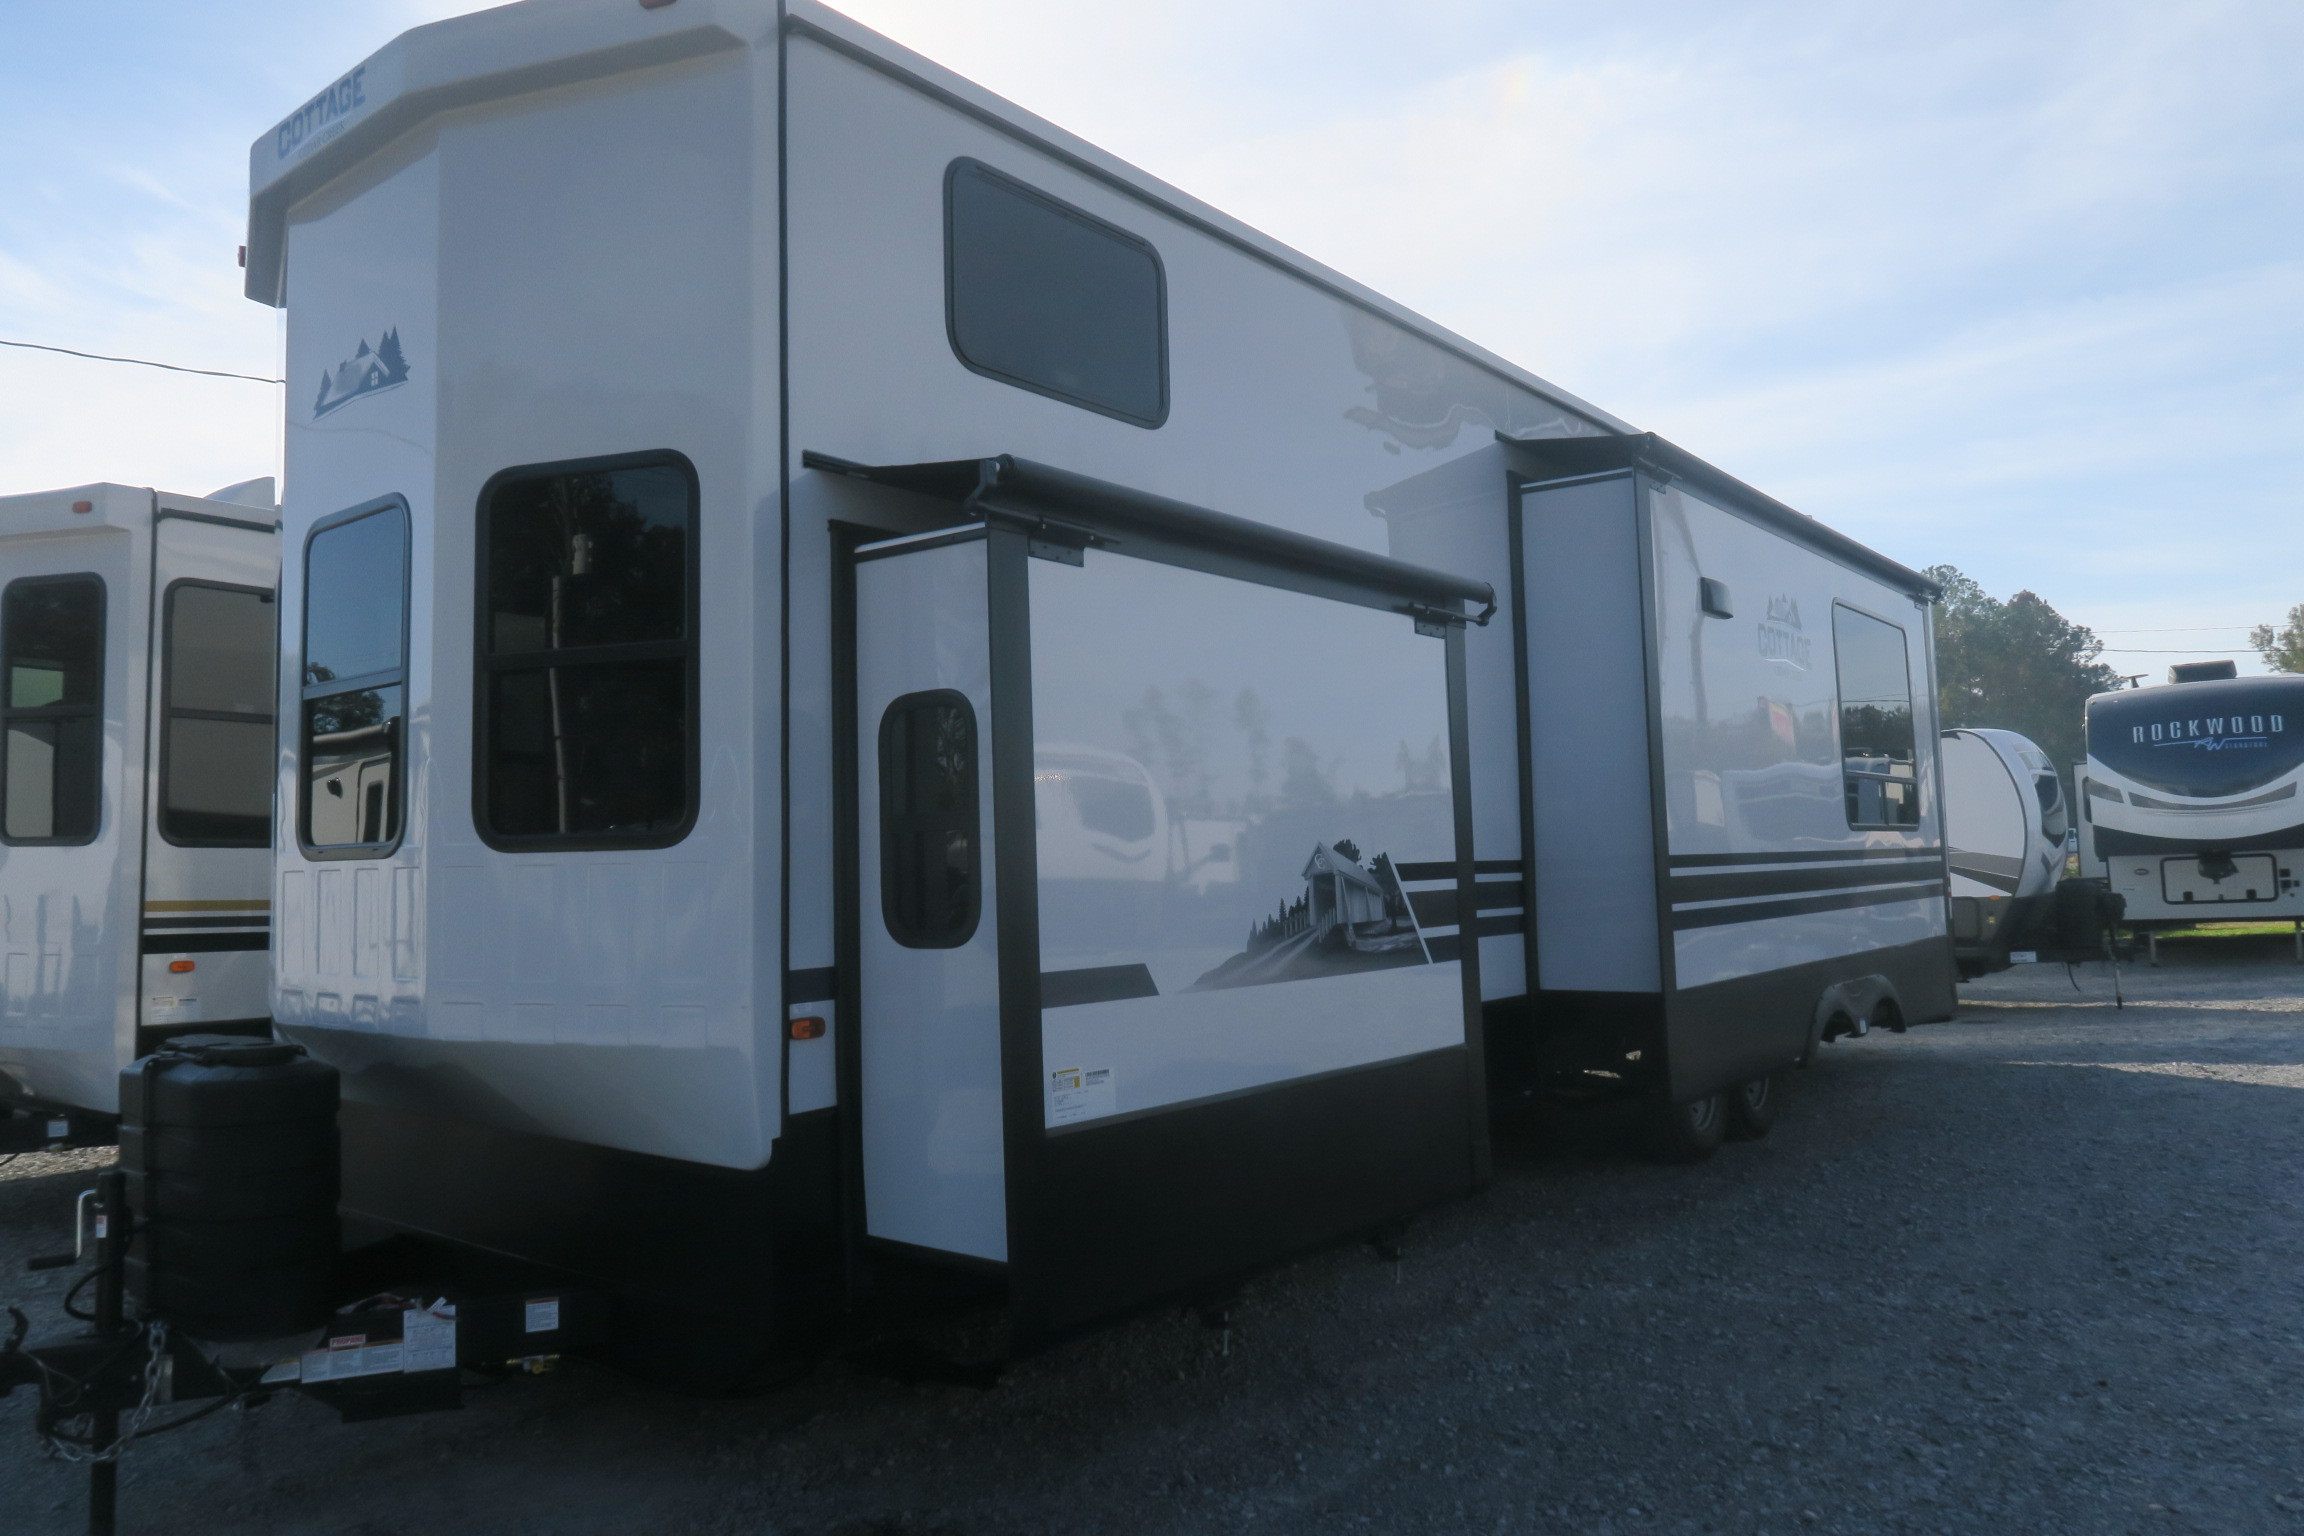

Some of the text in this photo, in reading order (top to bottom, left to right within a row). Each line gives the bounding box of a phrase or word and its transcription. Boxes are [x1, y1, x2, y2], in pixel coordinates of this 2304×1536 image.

[277, 66, 366, 160] COTTAGE
[1758, 622, 1813, 671] COTTAGE
[2132, 714, 2283, 744] ROCKWOOD
